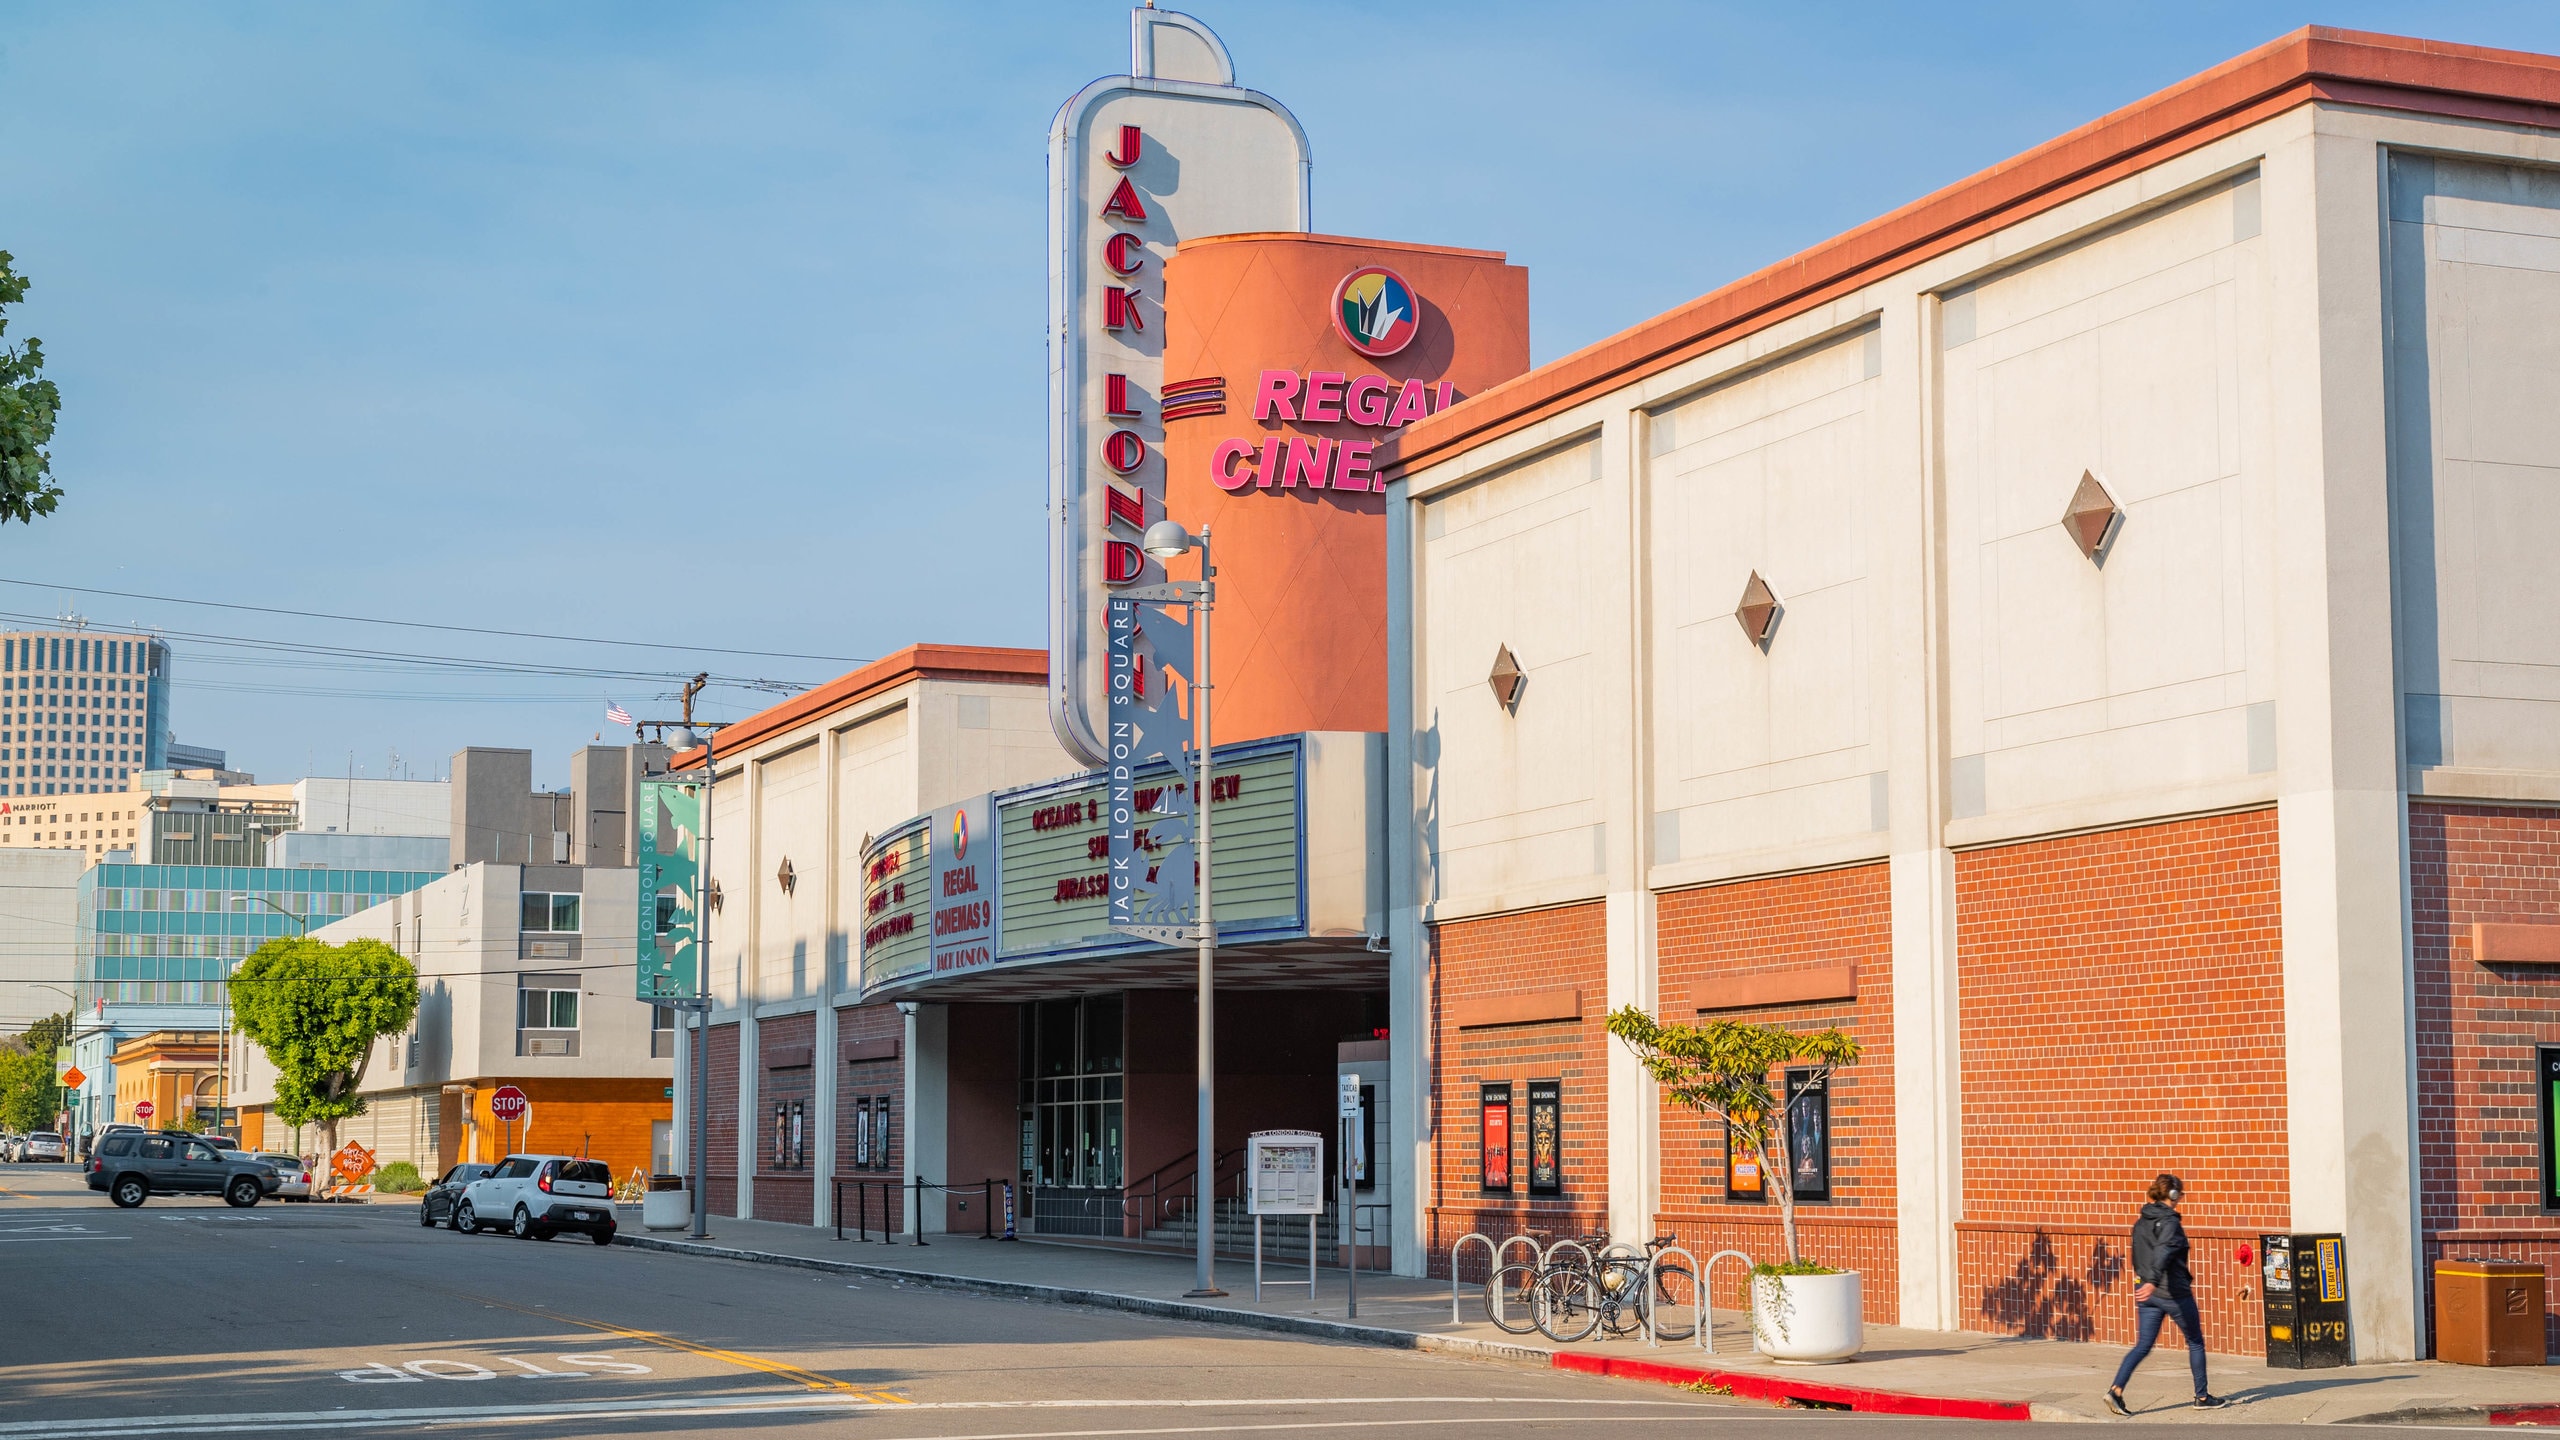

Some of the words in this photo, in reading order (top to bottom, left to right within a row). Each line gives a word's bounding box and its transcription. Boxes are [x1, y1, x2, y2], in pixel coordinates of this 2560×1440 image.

[1099, 124, 1147, 332] JACK
[1210, 436, 1387, 493] CINE
[1100, 372, 1146, 699] LOND
[1113, 601, 1131, 705] SQUARE
[1113, 722, 1129, 839] LONDON
[13, 802, 57, 811] MARRIOTT
[643, 783, 655, 852] SQUARE
[1032, 802, 1082, 831] OCEANS
[1088, 799, 1098, 822] 8
[943, 865, 978, 898] REGAL
[1053, 873, 1109, 902] JURASSI
[1113, 857, 1129, 922] JACK
[641, 863, 653, 941] LONDON
[935, 901, 980, 937] CINEMAS
[982, 900, 990, 928] 9
[640, 952, 651, 996] JACK
[936, 951, 953, 972] JACK
[956, 945, 990, 968] LONDON
[136, 1106, 154, 1114] STOP
[493, 1097, 524, 1110] STOP
[1343, 1095, 1355, 1103] ONLY
[2325, 1241, 2334, 1270] EXPRESS
[2327, 1270, 2335, 1283] BAY
[2328, 1284, 2336, 1300] EAST
[2303, 1320, 2346, 1341] 1978
[335, 1354, 652, 1383] STOP
